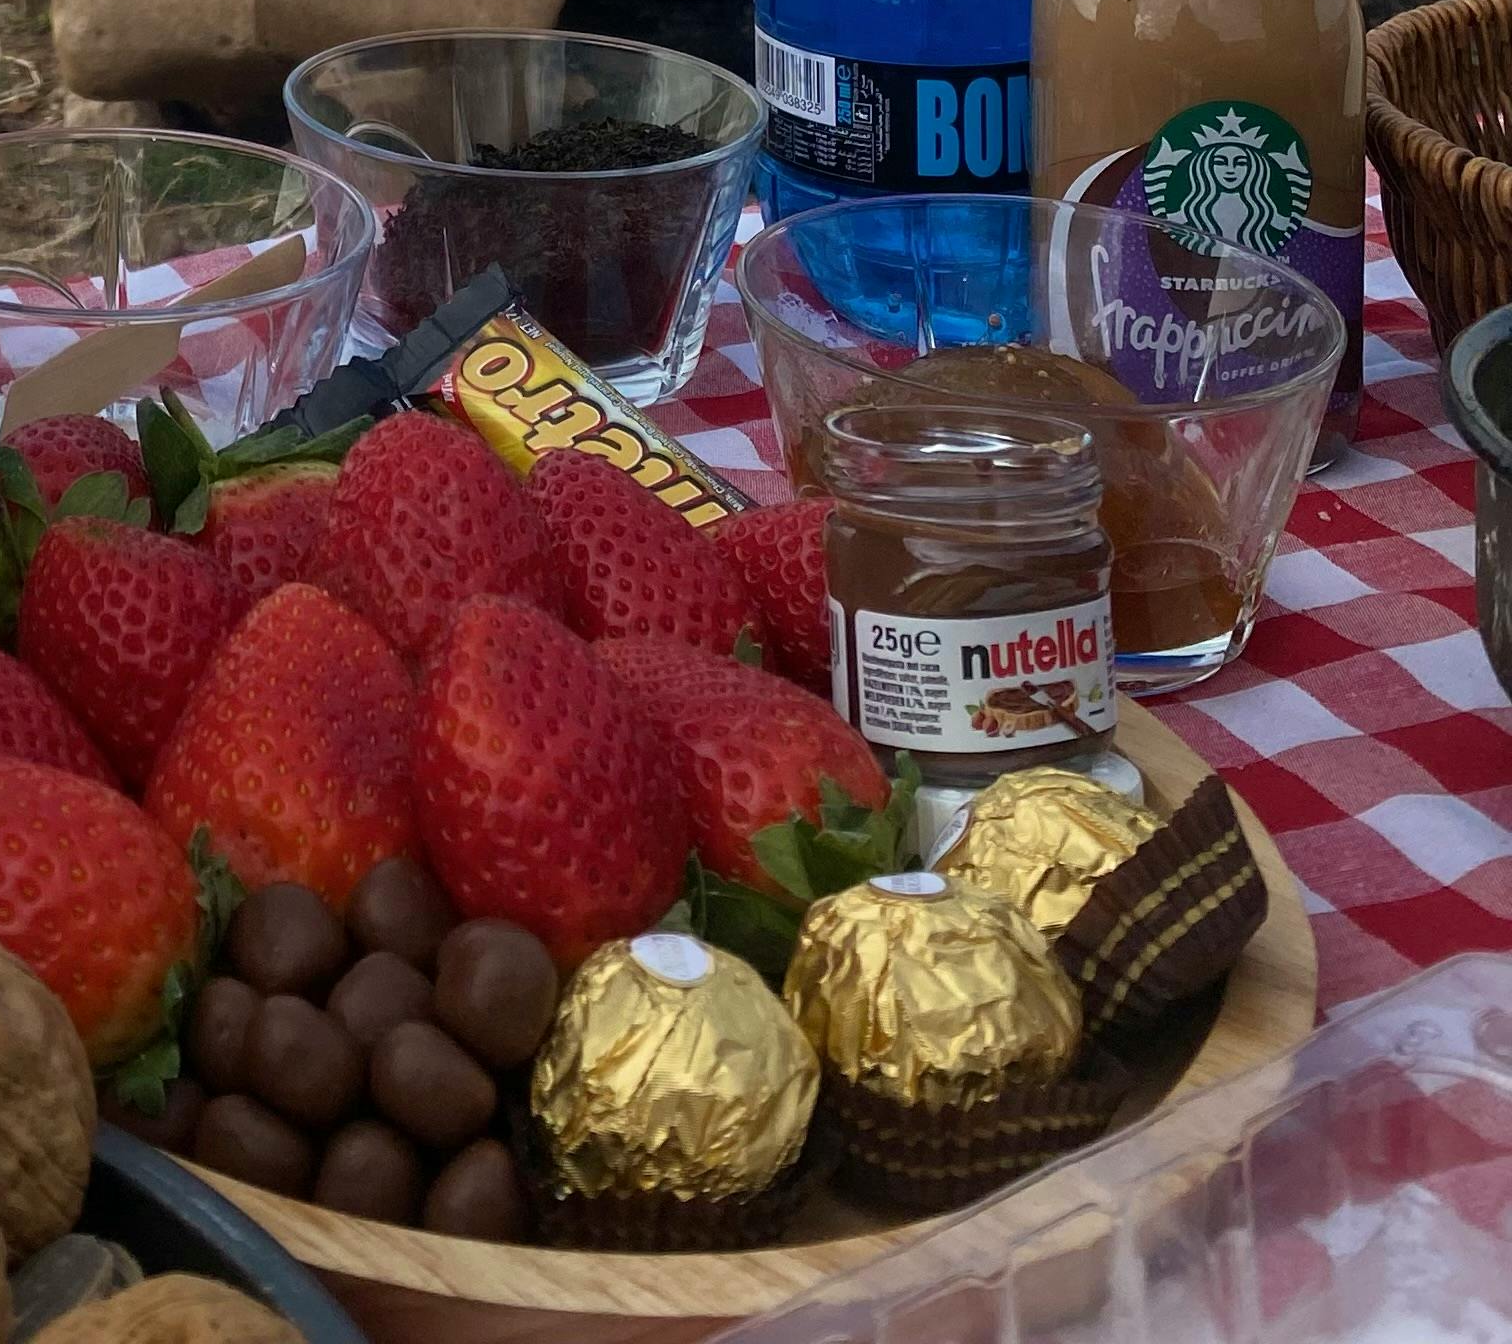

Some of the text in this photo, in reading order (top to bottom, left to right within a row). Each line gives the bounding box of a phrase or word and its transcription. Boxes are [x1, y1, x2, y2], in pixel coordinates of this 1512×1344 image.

[837, 100, 852, 126] 250
[518, 322, 543, 340] NET
[1217, 364, 1265, 381] OFFEE
[724, 493, 745, 512] Milk
[960, 618, 1100, 681] nutella
